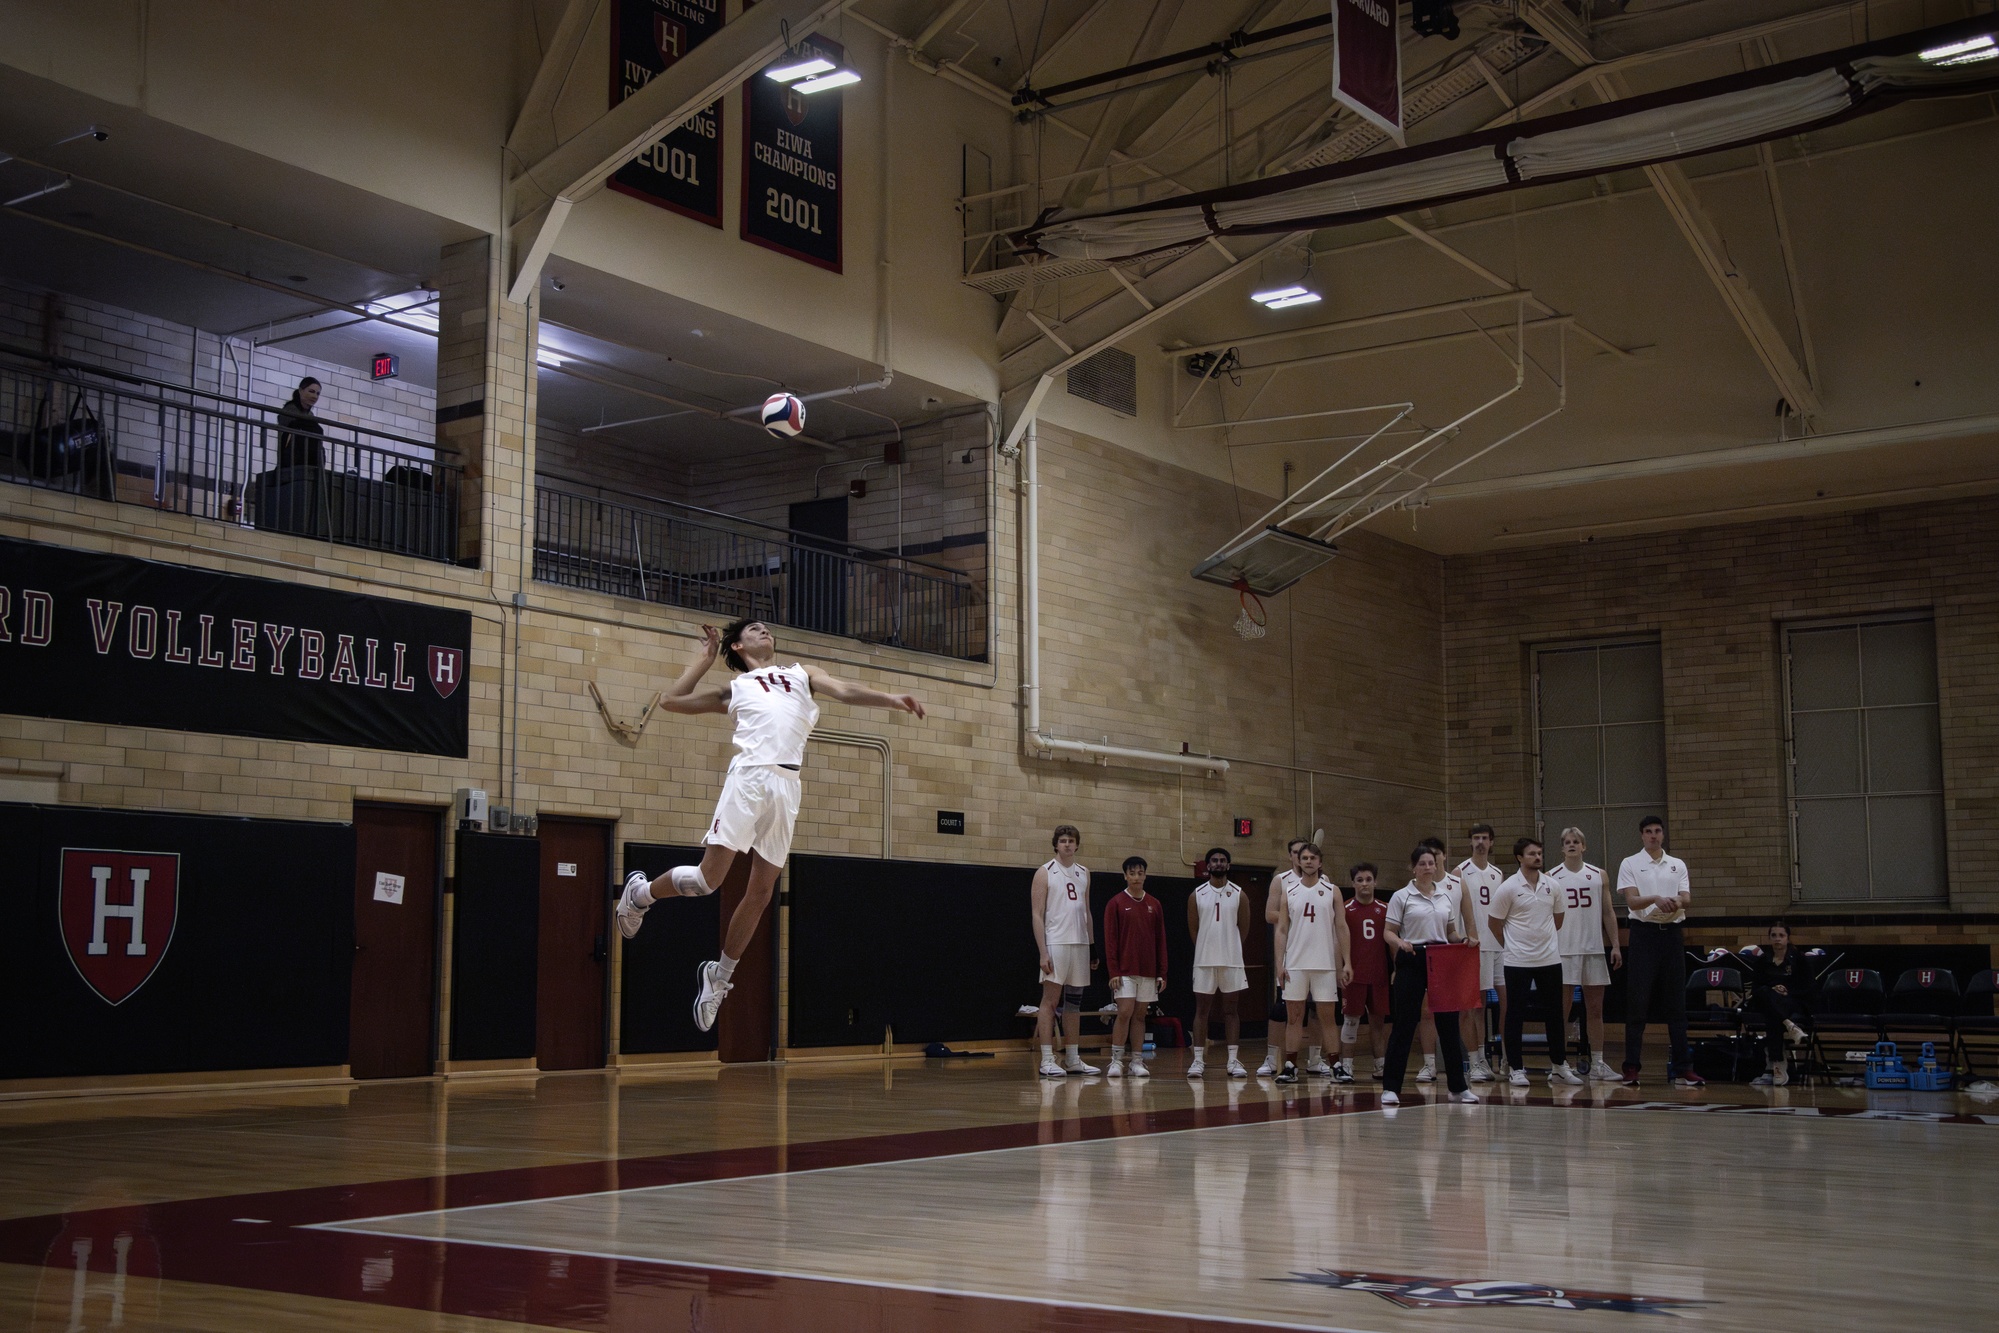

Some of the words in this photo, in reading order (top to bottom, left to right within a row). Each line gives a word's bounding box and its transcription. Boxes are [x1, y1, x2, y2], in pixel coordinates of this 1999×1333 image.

[661, 20, 679, 58] H
[777, 128, 813, 159] EIWA
[754, 141, 836, 190] CHAMPIONS
[765, 186, 822, 235] 2001
[375, 357, 391, 377] EXIT
[86, 598, 415, 692] VOLLEYBALL
[436, 651, 455, 684] H
[755, 673, 791, 692] 14
[940, 818, 957, 826] COURT
[1066, 882, 1078, 901] 8
[1479, 885, 1491, 906] 9
[1566, 887, 1592, 909] 35
[87, 866, 151, 956] H
[1215, 902, 1220, 922] 1
[1303, 902, 1316, 923] 4
[1362, 918, 1376, 940] 6
[1710, 970, 1720, 982] H
[1849, 971, 1860, 984] H
[1921, 971, 1932, 984] H
